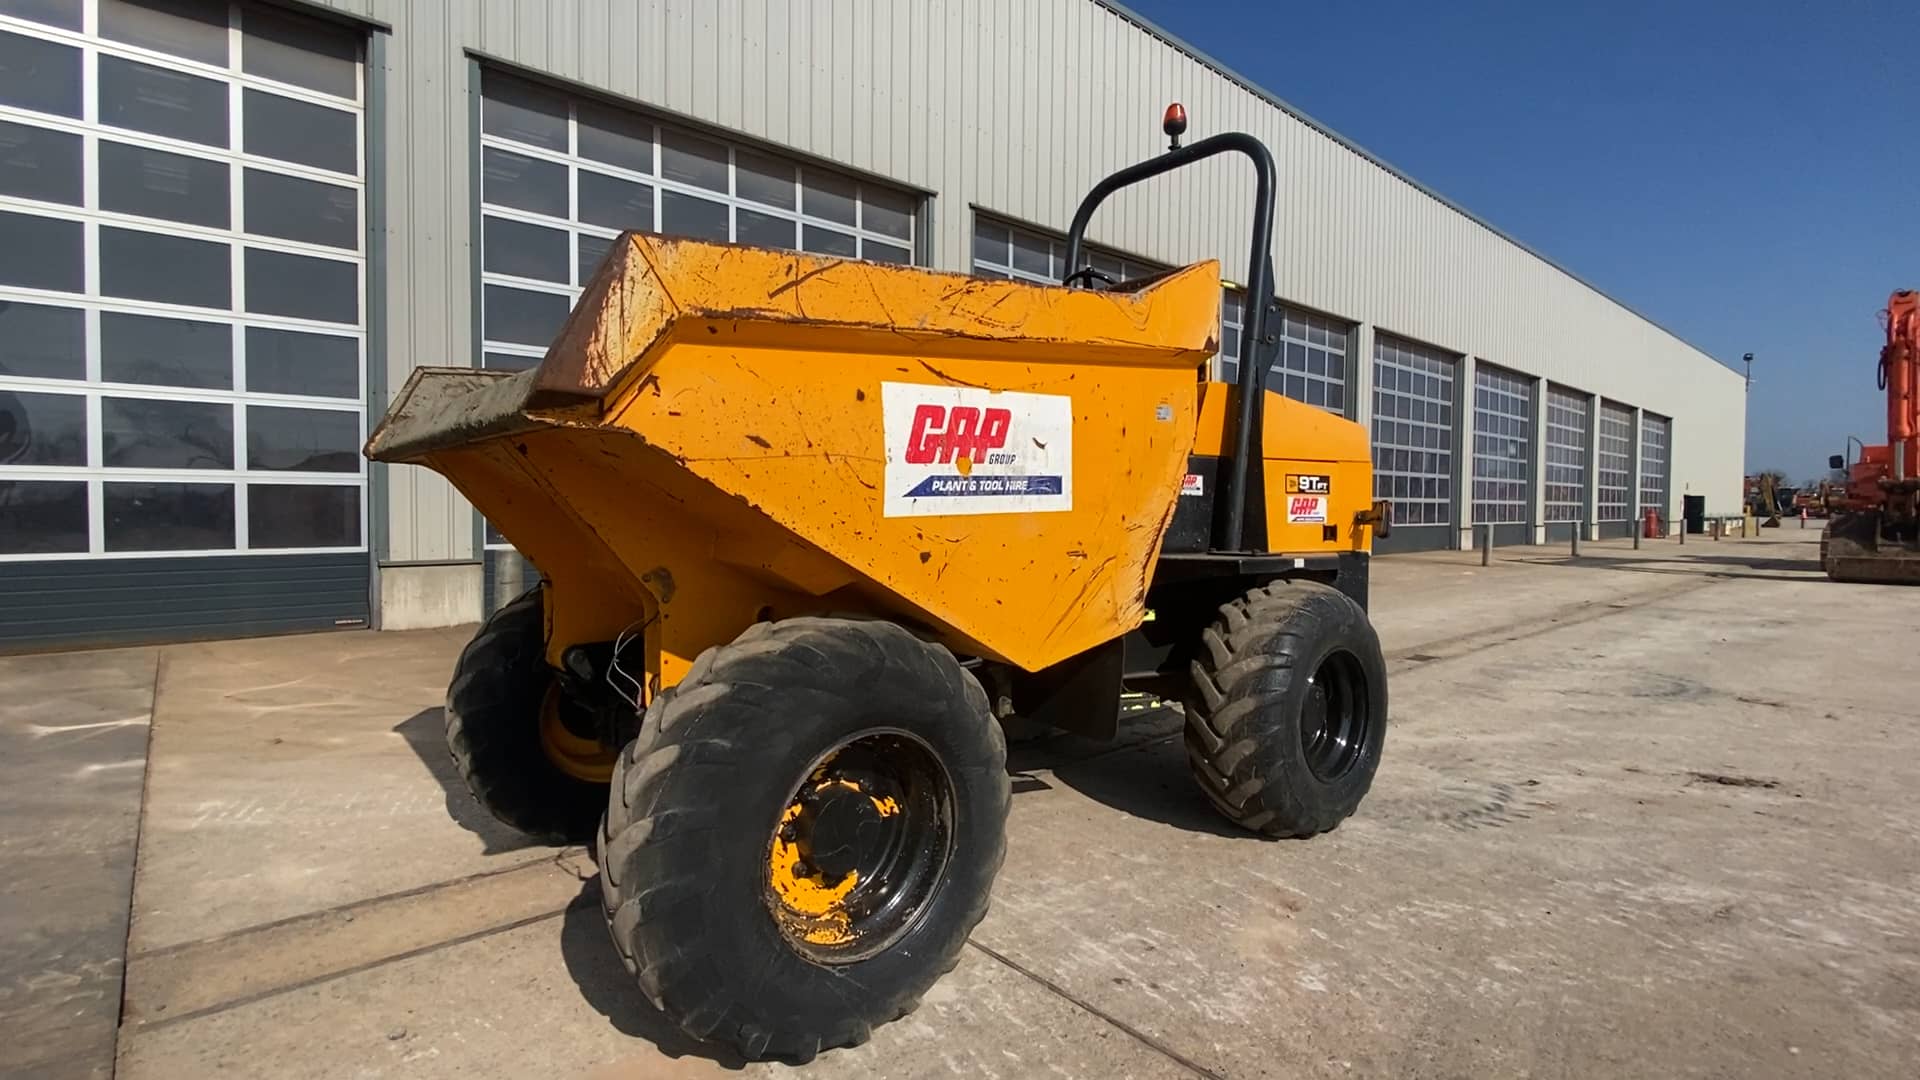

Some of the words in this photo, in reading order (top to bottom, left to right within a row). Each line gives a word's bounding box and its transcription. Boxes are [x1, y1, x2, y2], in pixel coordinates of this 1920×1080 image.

[905, 404, 1012, 464] GAP
[988, 453, 1017, 465] GROUP
[932, 480, 968, 491] PLANT
[969, 481, 977, 491] &
[980, 480, 1006, 491] TOOL
[1005, 481, 1028, 491] HIRE
[1290, 498, 1319, 515] GAP
